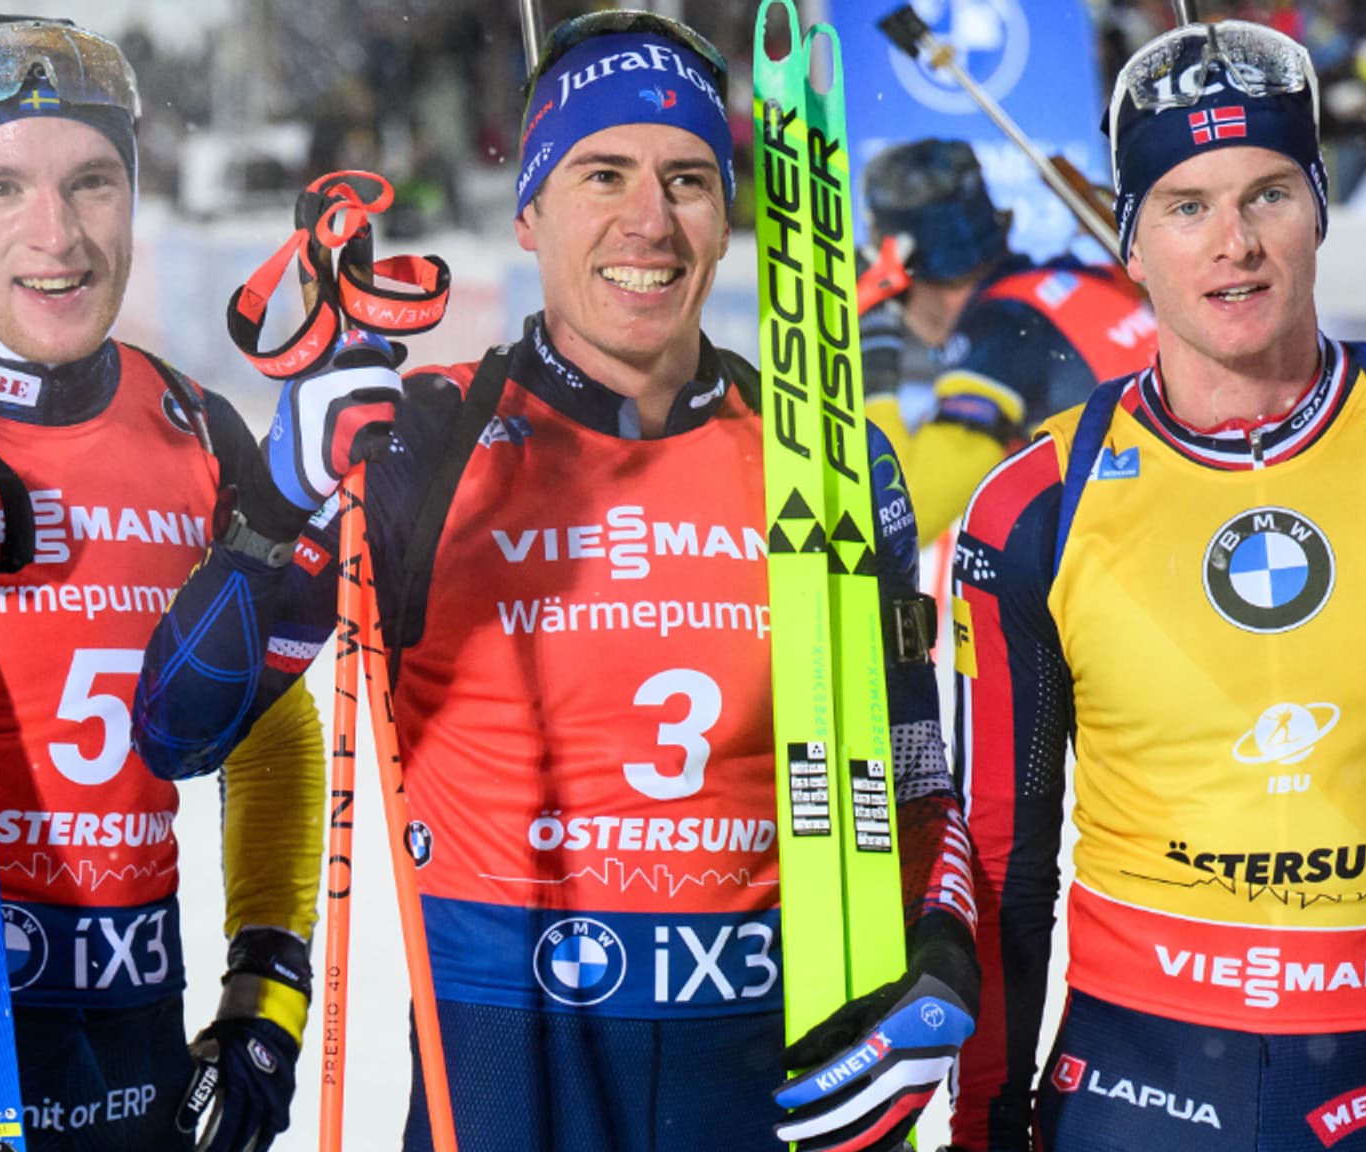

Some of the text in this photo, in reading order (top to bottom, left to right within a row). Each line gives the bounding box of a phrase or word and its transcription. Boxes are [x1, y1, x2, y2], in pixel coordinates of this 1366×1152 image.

[558, 43, 729, 124] JuraFlor
[766, 101, 811, 459] FISCHER
[808, 129, 860, 485] FISCHER
[492, 505, 768, 580] VIESSMAN
[1219, 513, 1313, 552] BMW
[497, 598, 771, 640] Wärmepump
[47, 648, 147, 786] 5
[622, 668, 723, 800] 3
[1267, 773, 1311, 794] IBU
[74, 909, 169, 989] iX3
[653, 923, 779, 1003] iX3
[106, 1082, 157, 1122] ERP
[1087, 1069, 1223, 1130] LAPUA
